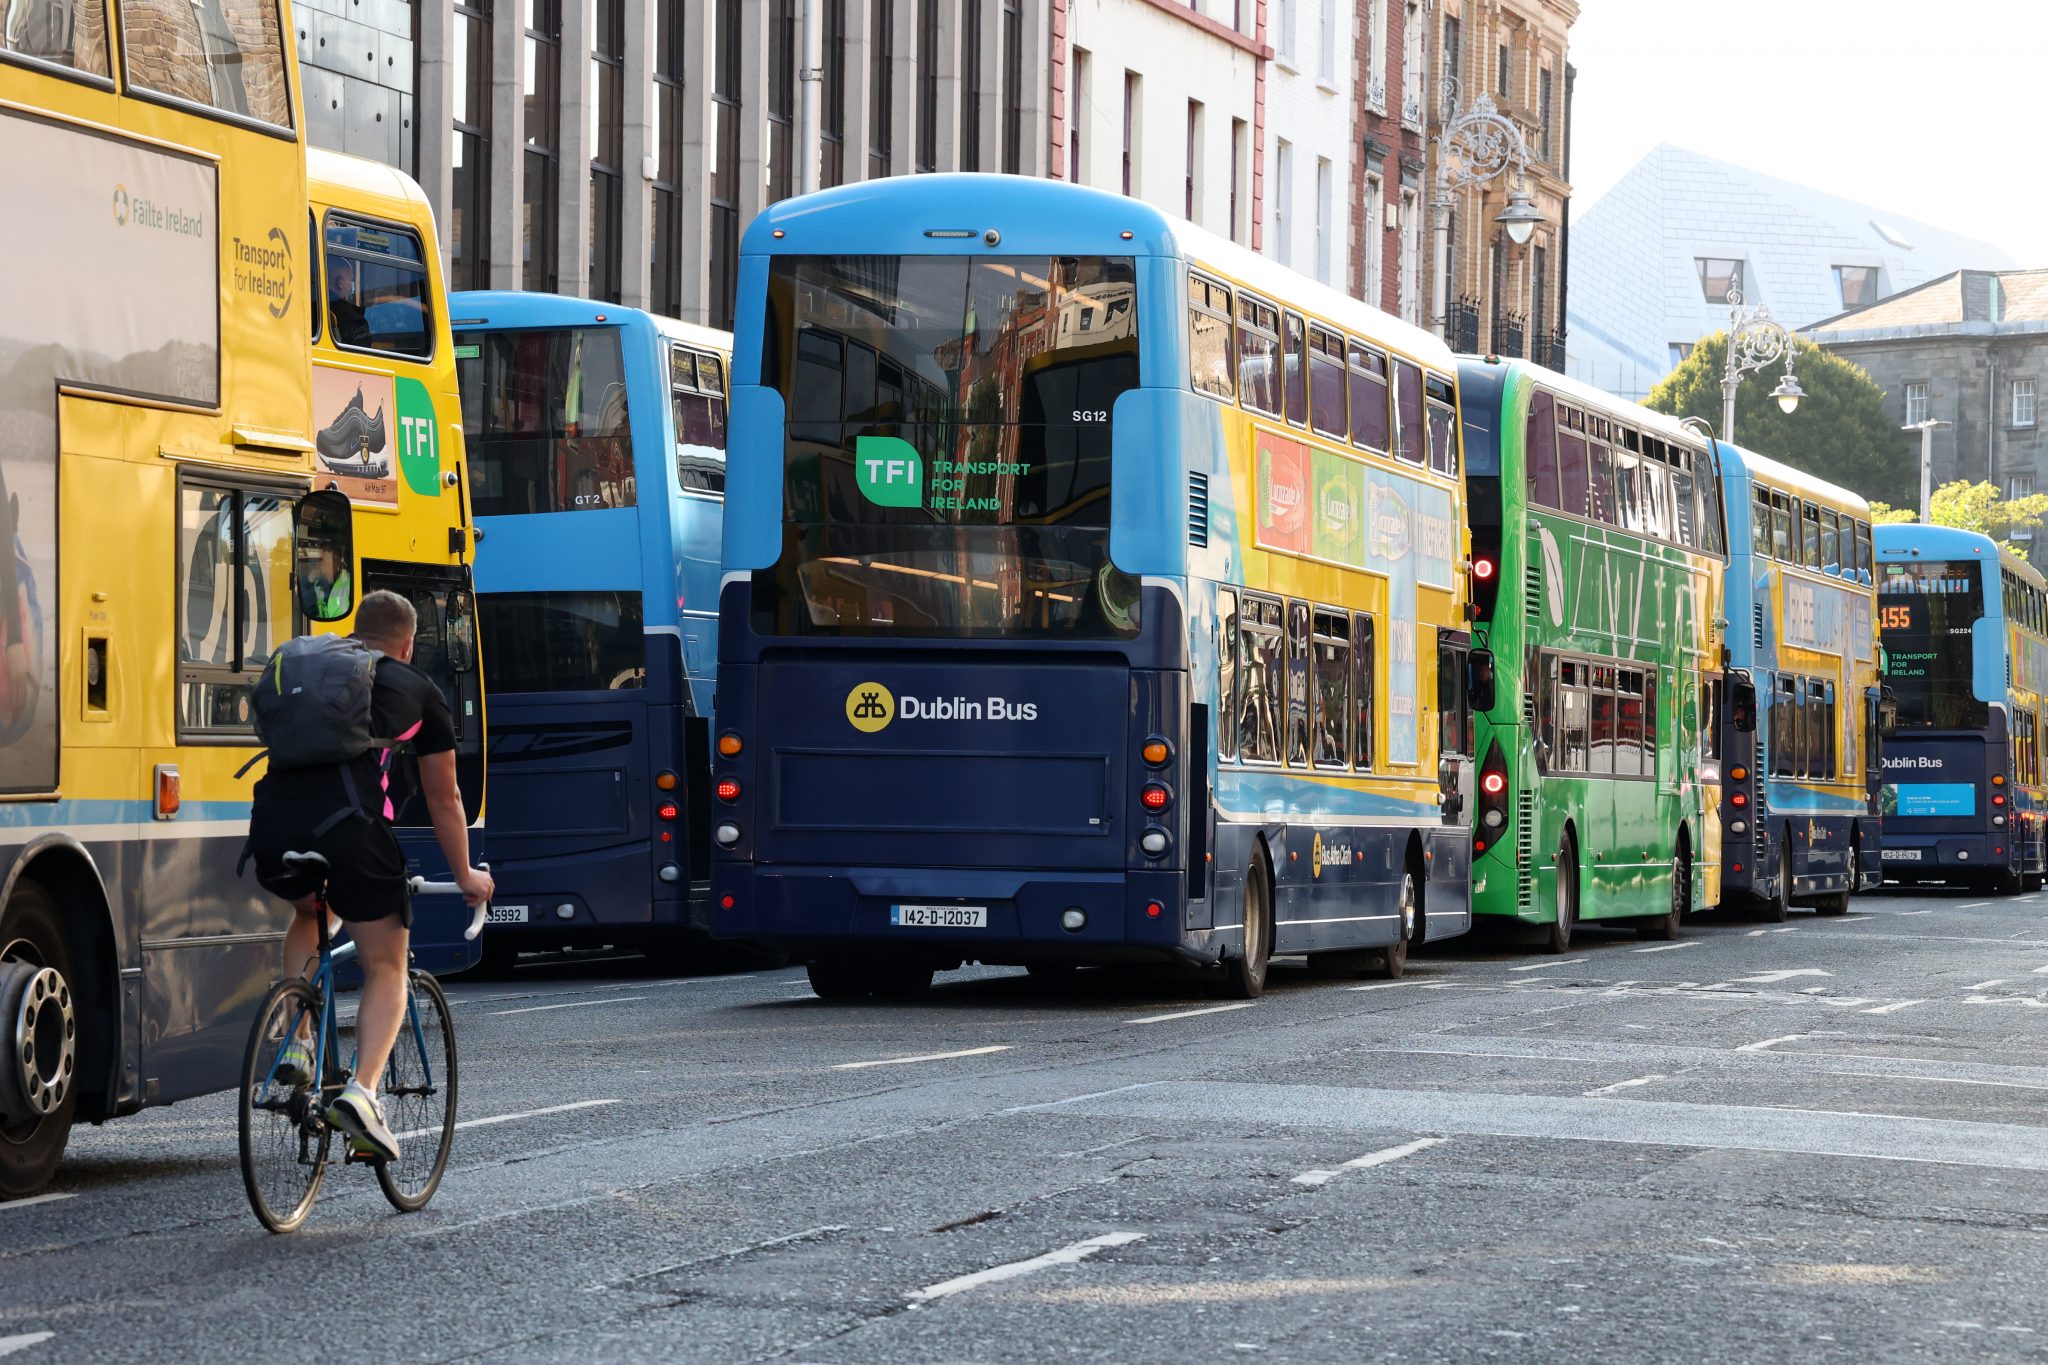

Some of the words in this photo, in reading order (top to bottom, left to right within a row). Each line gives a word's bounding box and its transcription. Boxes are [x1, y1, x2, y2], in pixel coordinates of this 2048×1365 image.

[133, 198, 163, 229] Fáilte
[165, 206, 203, 238] Ireland
[233, 237, 286, 270] Transport
[234, 267, 248, 291] for
[249, 270, 286, 300] Ireland
[1072, 410, 1107, 422] SG12
[401, 416, 435, 458] TFI
[864, 459, 915, 485] TFI
[933, 460, 1031, 476] TRANSPORT
[931, 478, 965, 492] FOR
[575, 495, 591, 505] GT
[593, 495, 600, 504] 2
[930, 497, 1002, 511] IRELAND
[1880, 606, 1911, 629] 155
[1949, 627, 1972, 635] SG224
[900, 696, 982, 720] Dublin
[987, 697, 1038, 721] Bus
[1918, 756, 1943, 768] Bus
[904, 909, 980, 926] 142-D-12037
